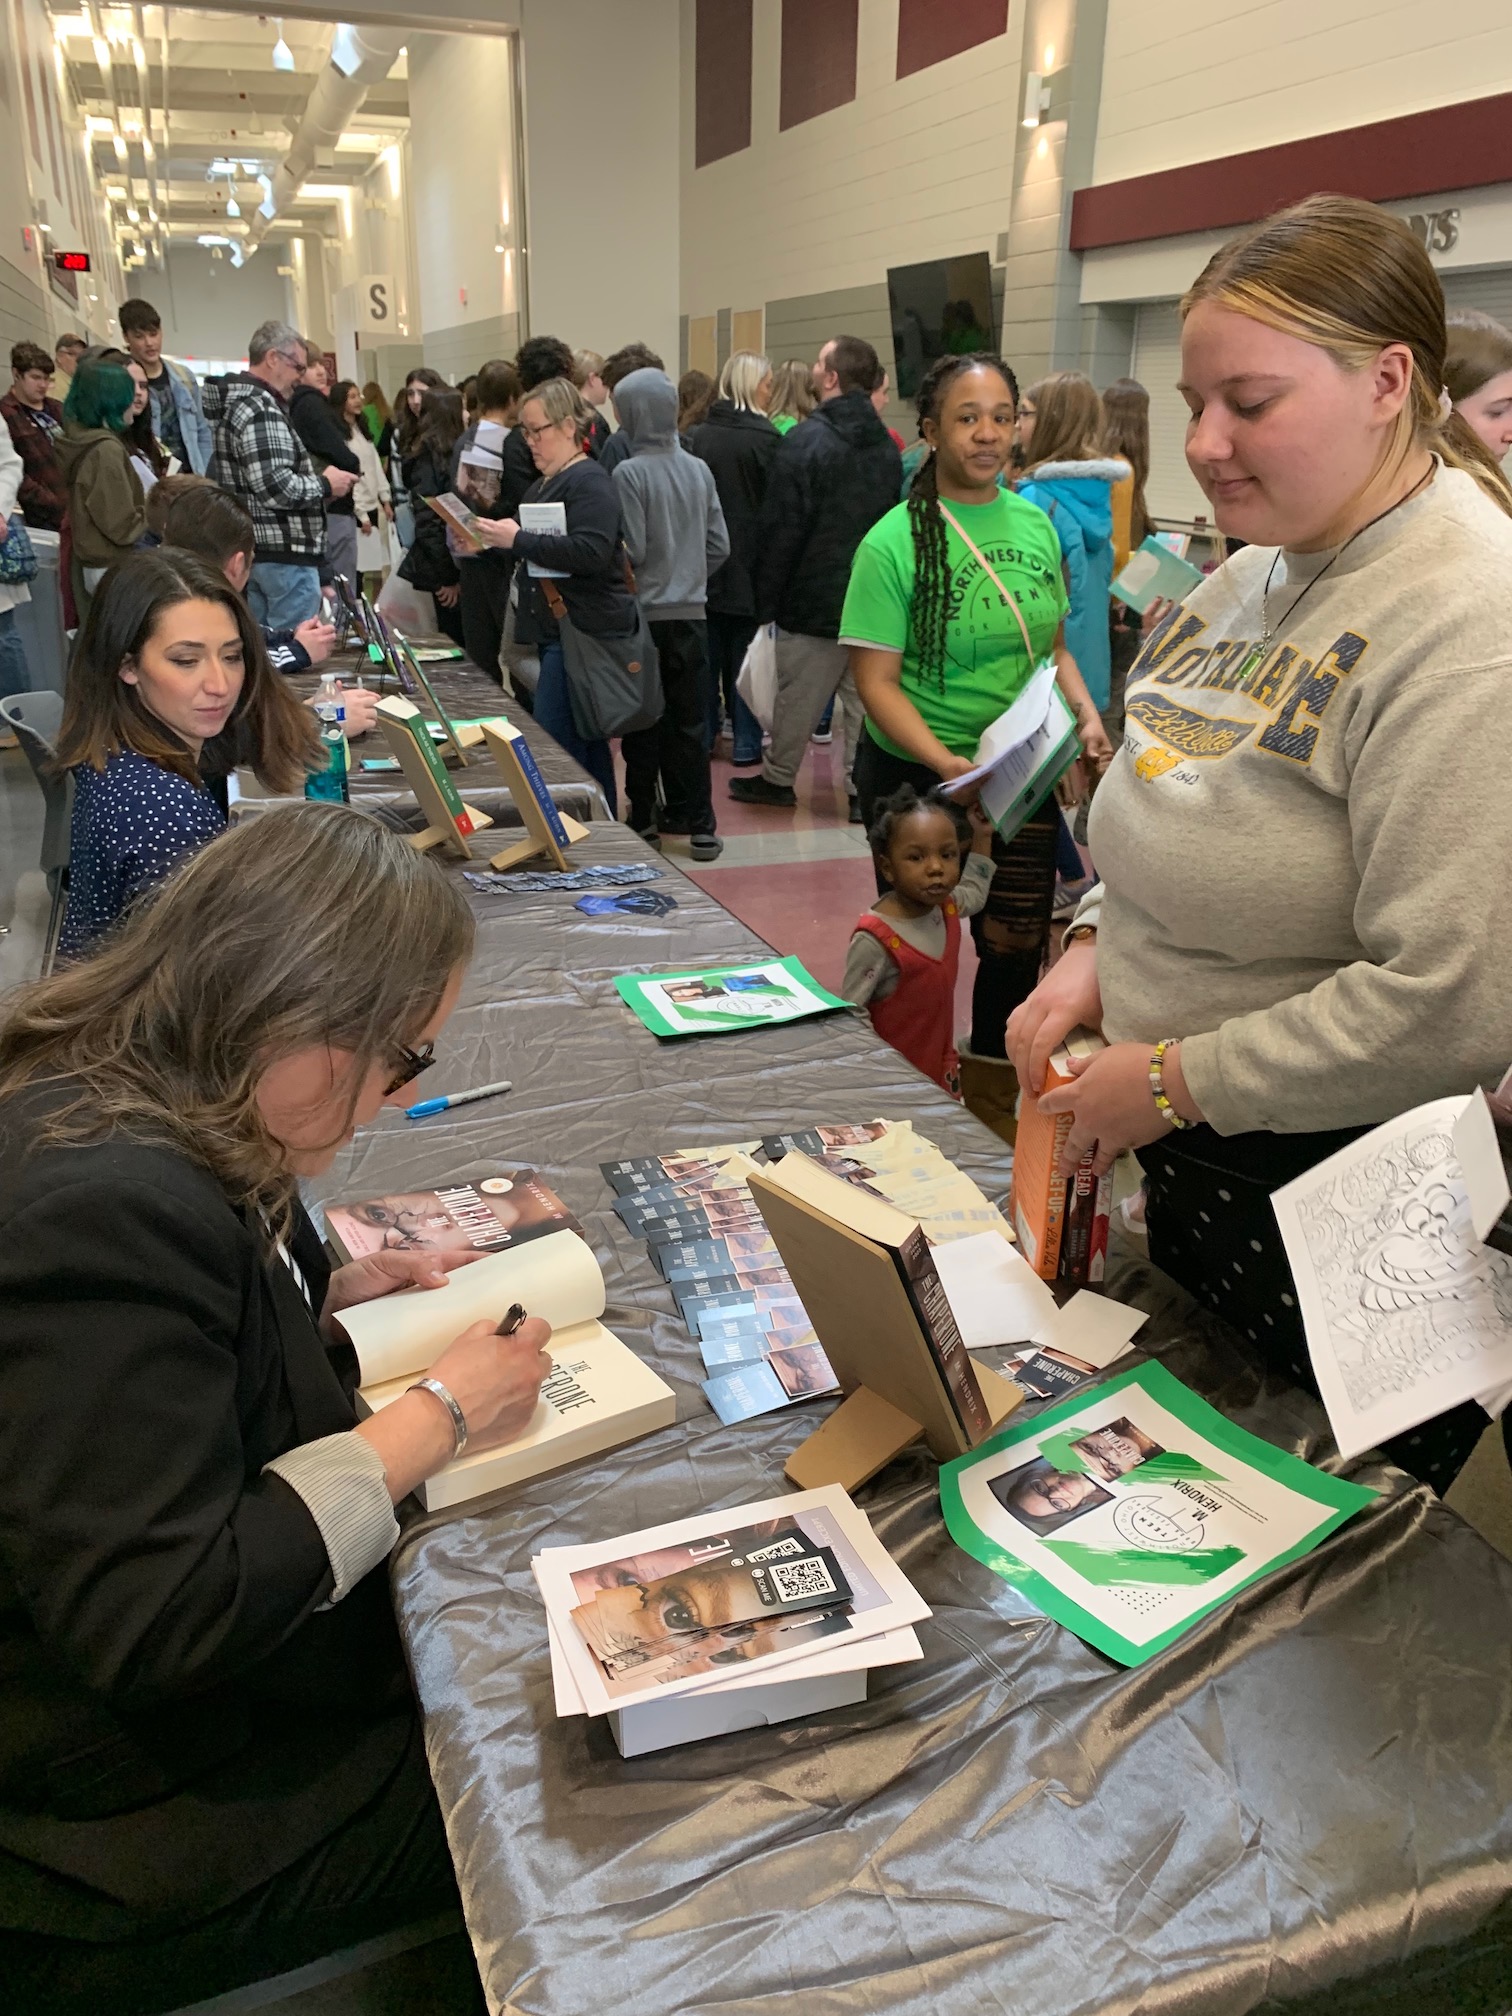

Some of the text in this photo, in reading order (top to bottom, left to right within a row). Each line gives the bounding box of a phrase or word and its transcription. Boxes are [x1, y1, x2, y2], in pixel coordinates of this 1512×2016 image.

[369, 283, 388, 320] S
[981, 587, 1040, 610] TEEN
[517, 742, 547, 799] AMONG THIEVES
[1170, 770, 1200, 786] 1842
[525, 1182, 557, 1212] HENDRIX
[1047, 1170, 1068, 1213] SET-UP
[1077, 1168, 1092, 1197] DEAD
[434, 1184, 512, 1248] CHAPERONE
[680, 1245, 700, 1268] APERONE
[921, 1273, 933, 1292] THE
[923, 1282, 962, 1361] CHAPERONE
[569, 1361, 592, 1374] THE
[1032, 1358, 1081, 1385] CHAPERONE
[541, 1359, 596, 1415] ERONE
[957, 1373, 977, 1415] HENDRIX
[1170, 1478, 1223, 1513] HENDRIX
[1139, 1516, 1168, 1537] TEEN
[1191, 1508, 1209, 1521] M.
[811, 1516, 834, 1545] EXCERPT
[756, 1578, 773, 1602] SCAN ME
[847, 1571, 869, 1597] LIMITED
